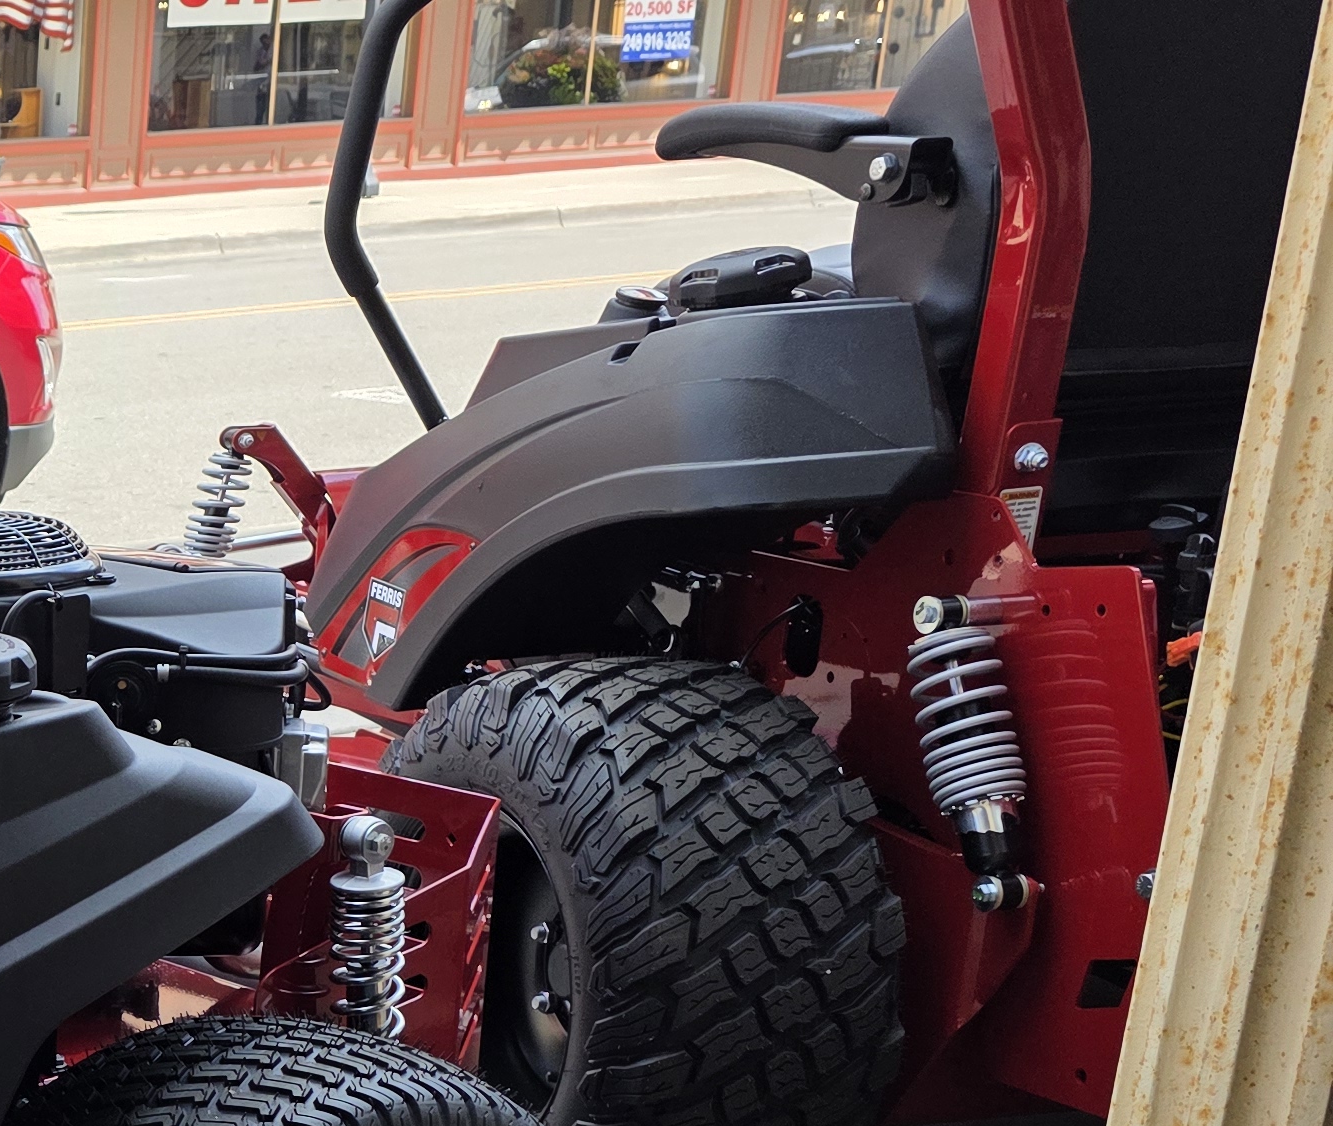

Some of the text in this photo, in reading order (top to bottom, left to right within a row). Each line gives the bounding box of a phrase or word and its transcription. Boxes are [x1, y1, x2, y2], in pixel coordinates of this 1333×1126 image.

[627, 0, 694, 18] 20,500 SF
[370, 581, 403, 608] FERRIS
